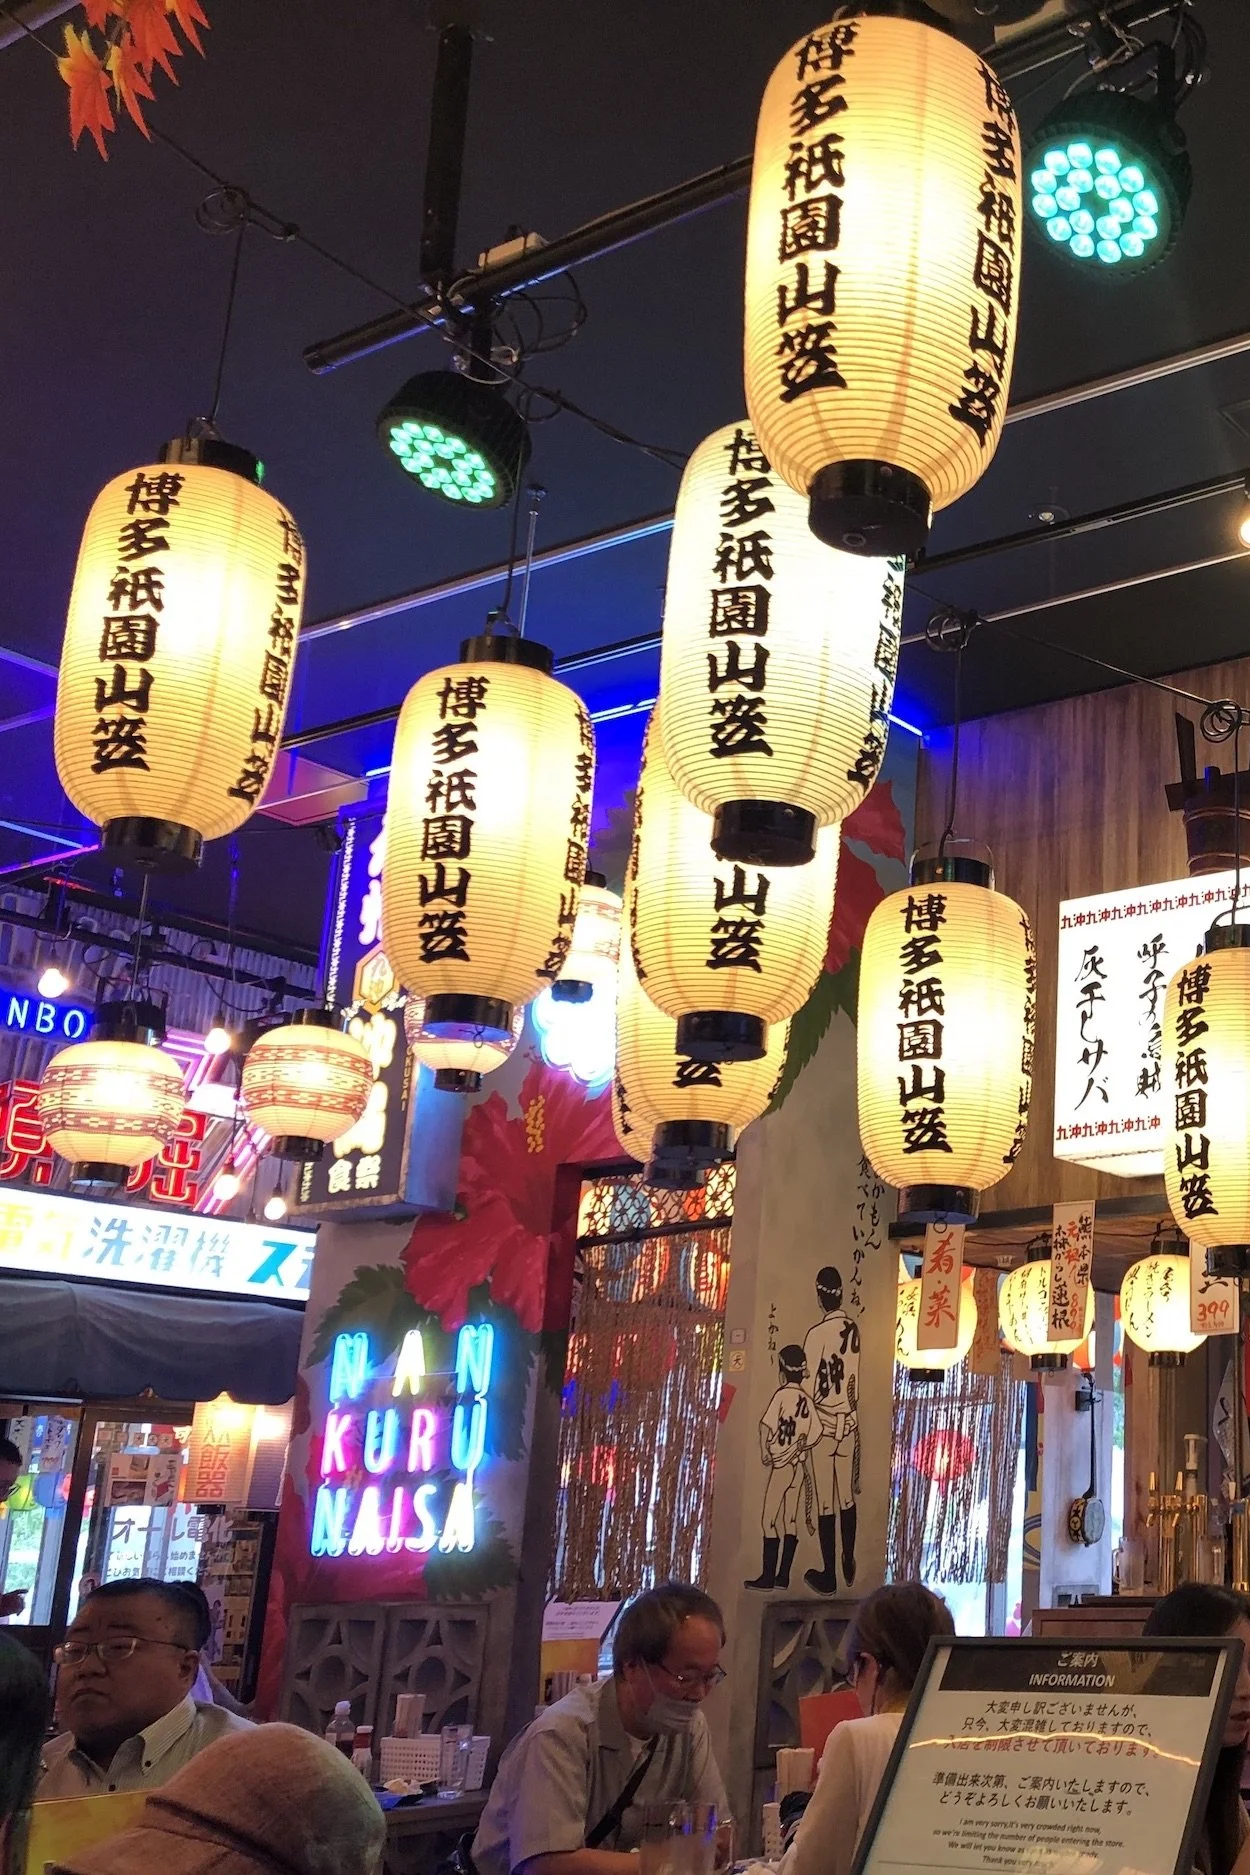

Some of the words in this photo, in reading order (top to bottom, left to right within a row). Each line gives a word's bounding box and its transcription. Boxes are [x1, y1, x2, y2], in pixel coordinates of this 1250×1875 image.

[775, 21, 861, 404] 博多祇園山笠
[90, 471, 185, 775] 博多祇園山笠
[417, 675, 490, 964] 博多祇園山笠
[897, 893, 953, 1155] 博多祇園山笠
[1175, 963, 1219, 1219] 博多祇園山笠
[1197, 1299, 1229, 1321] 399
[331, 1323, 496, 1401] NAN
[320, 1398, 489, 1476] KURU
[310, 1482, 476, 1556] NAISA
[1028, 1673, 1115, 1688] INFORMATION
[1057, 1651, 1099, 1668] ご案内
[975, 1820, 990, 1829] very
[1020, 1822, 1035, 1832] very
[1036, 1823, 1067, 1833] crowded
[1067, 1824, 1084, 1833] right
[1036, 1836, 1060, 1844] people
[1061, 1837, 1090, 1847] entering
[1091, 1838, 1104, 1847] the
